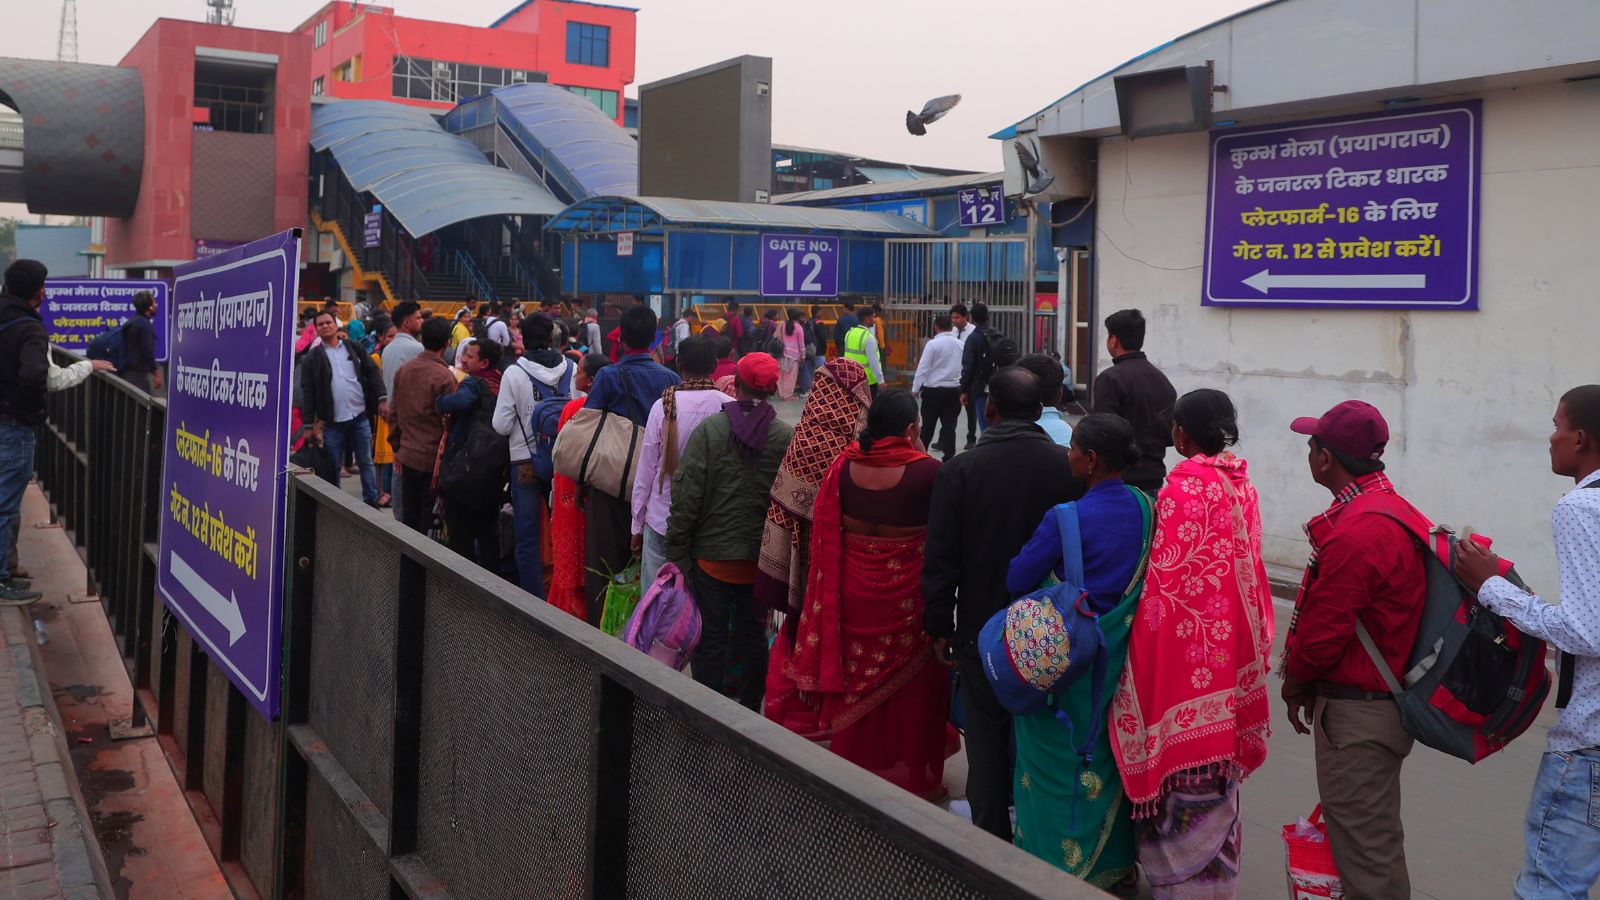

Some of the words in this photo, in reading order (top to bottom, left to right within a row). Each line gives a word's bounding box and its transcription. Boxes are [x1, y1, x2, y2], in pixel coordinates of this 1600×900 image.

[1230, 144, 1277, 169] कुम्भ
[1281, 138, 1325, 158] मेला
[1329, 124, 1451, 158] (प्रयागराज)
[1235, 176, 1255, 195] के
[1258, 173, 1323, 192] जनरल
[1386, 164, 1449, 186] धारक
[960, 192, 975, 204] गेट
[1363, 200, 1389, 222] के
[1391, 198, 1439, 221] लिए
[967, 203, 996, 223] 12
[769, 239, 806, 251] GATE
[809, 240, 832, 252] NO.
[1232, 240, 1262, 260] गेट
[1293, 243, 1313, 258] 12
[1316, 238, 1336, 259] से
[1339, 237, 1390, 259] प्रवेश
[778, 252, 822, 292] 12
[75, 285, 99, 297] मेला
[49, 301, 61, 312] के
[177, 301, 195, 343] कुम्भ
[195, 291, 215, 331] मेला
[215, 281, 273, 338] (प्रयागराज)
[177, 356, 185, 393] के
[184, 366, 211, 399] जनरल
[237, 371, 269, 410] धारक
[223, 435, 236, 482] के
[235, 438, 260, 492] लिए
[170, 481, 182, 523] गेट
[191, 504, 200, 539] 12
[200, 502, 210, 545] से
[209, 510, 233, 563] प्रवेश
